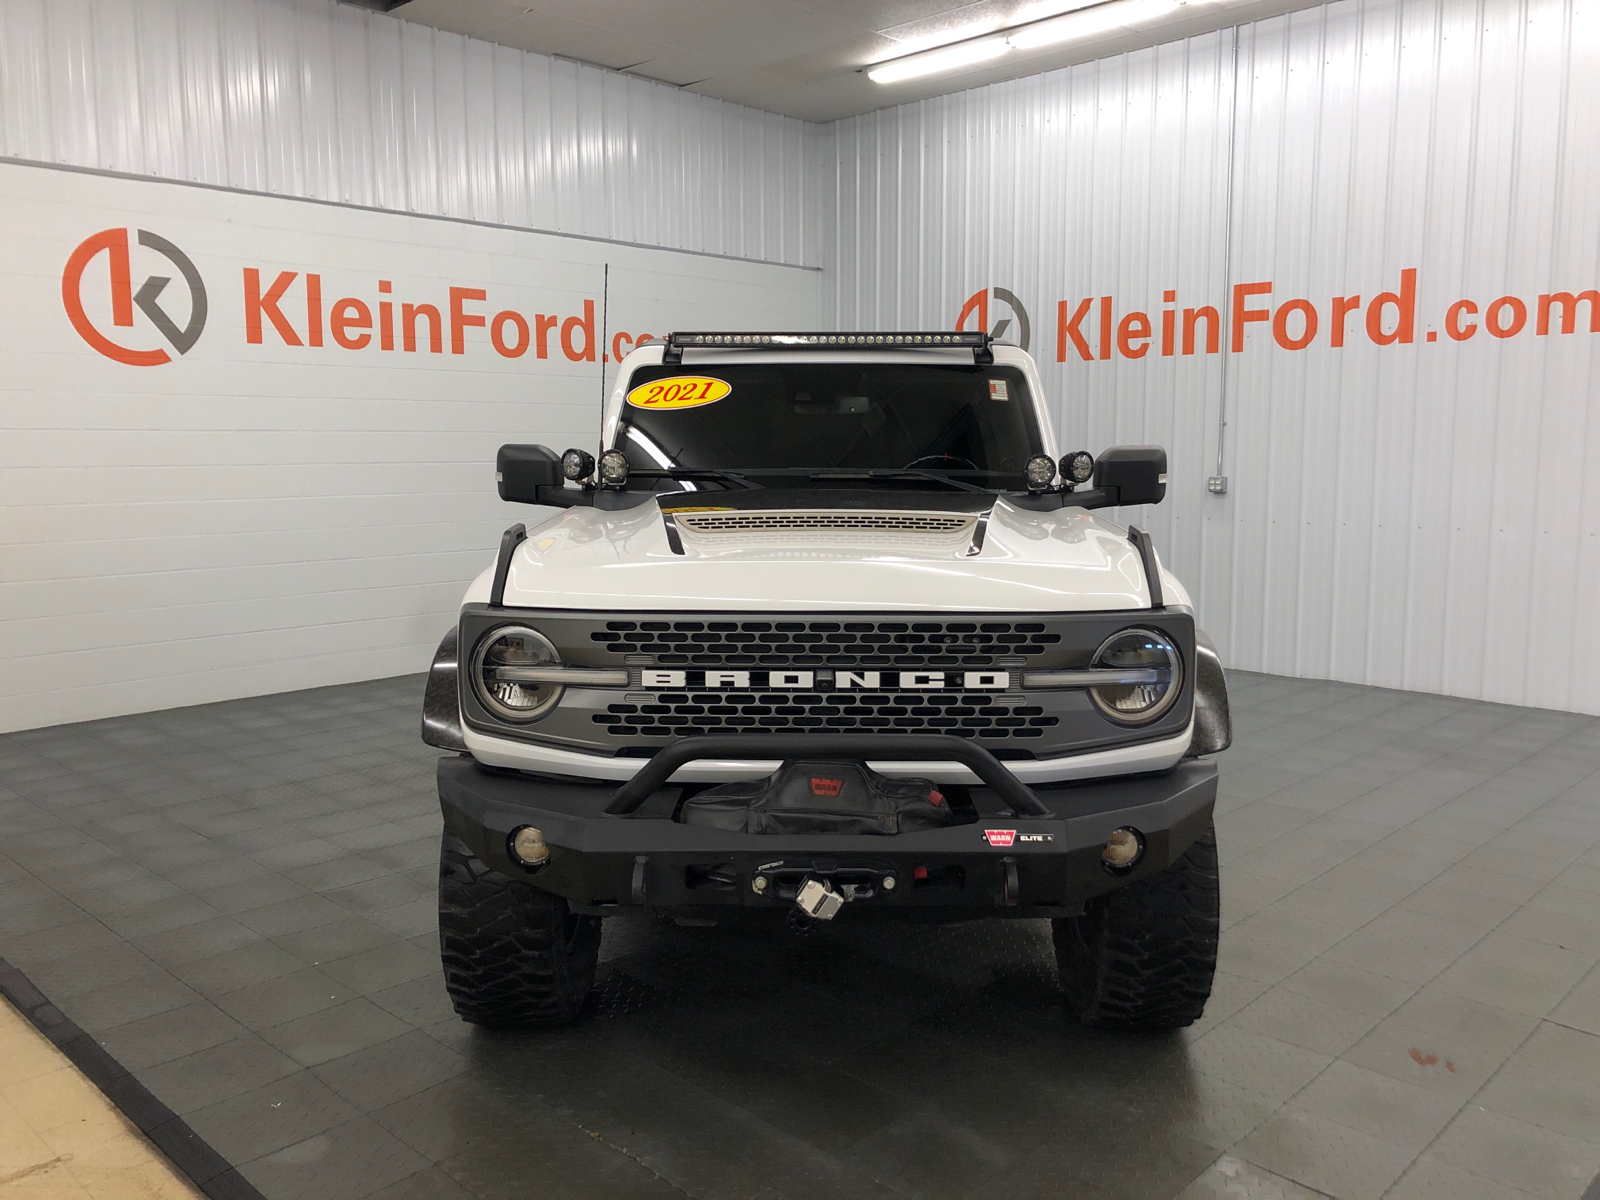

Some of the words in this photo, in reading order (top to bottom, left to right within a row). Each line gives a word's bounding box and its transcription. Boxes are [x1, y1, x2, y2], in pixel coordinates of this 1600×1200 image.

[242, 267, 668, 364] KleinFord.c
[1056, 267, 1600, 363] KleinFord.com
[643, 381, 714, 405] 2021
[641, 670, 1010, 688] BRONCO
